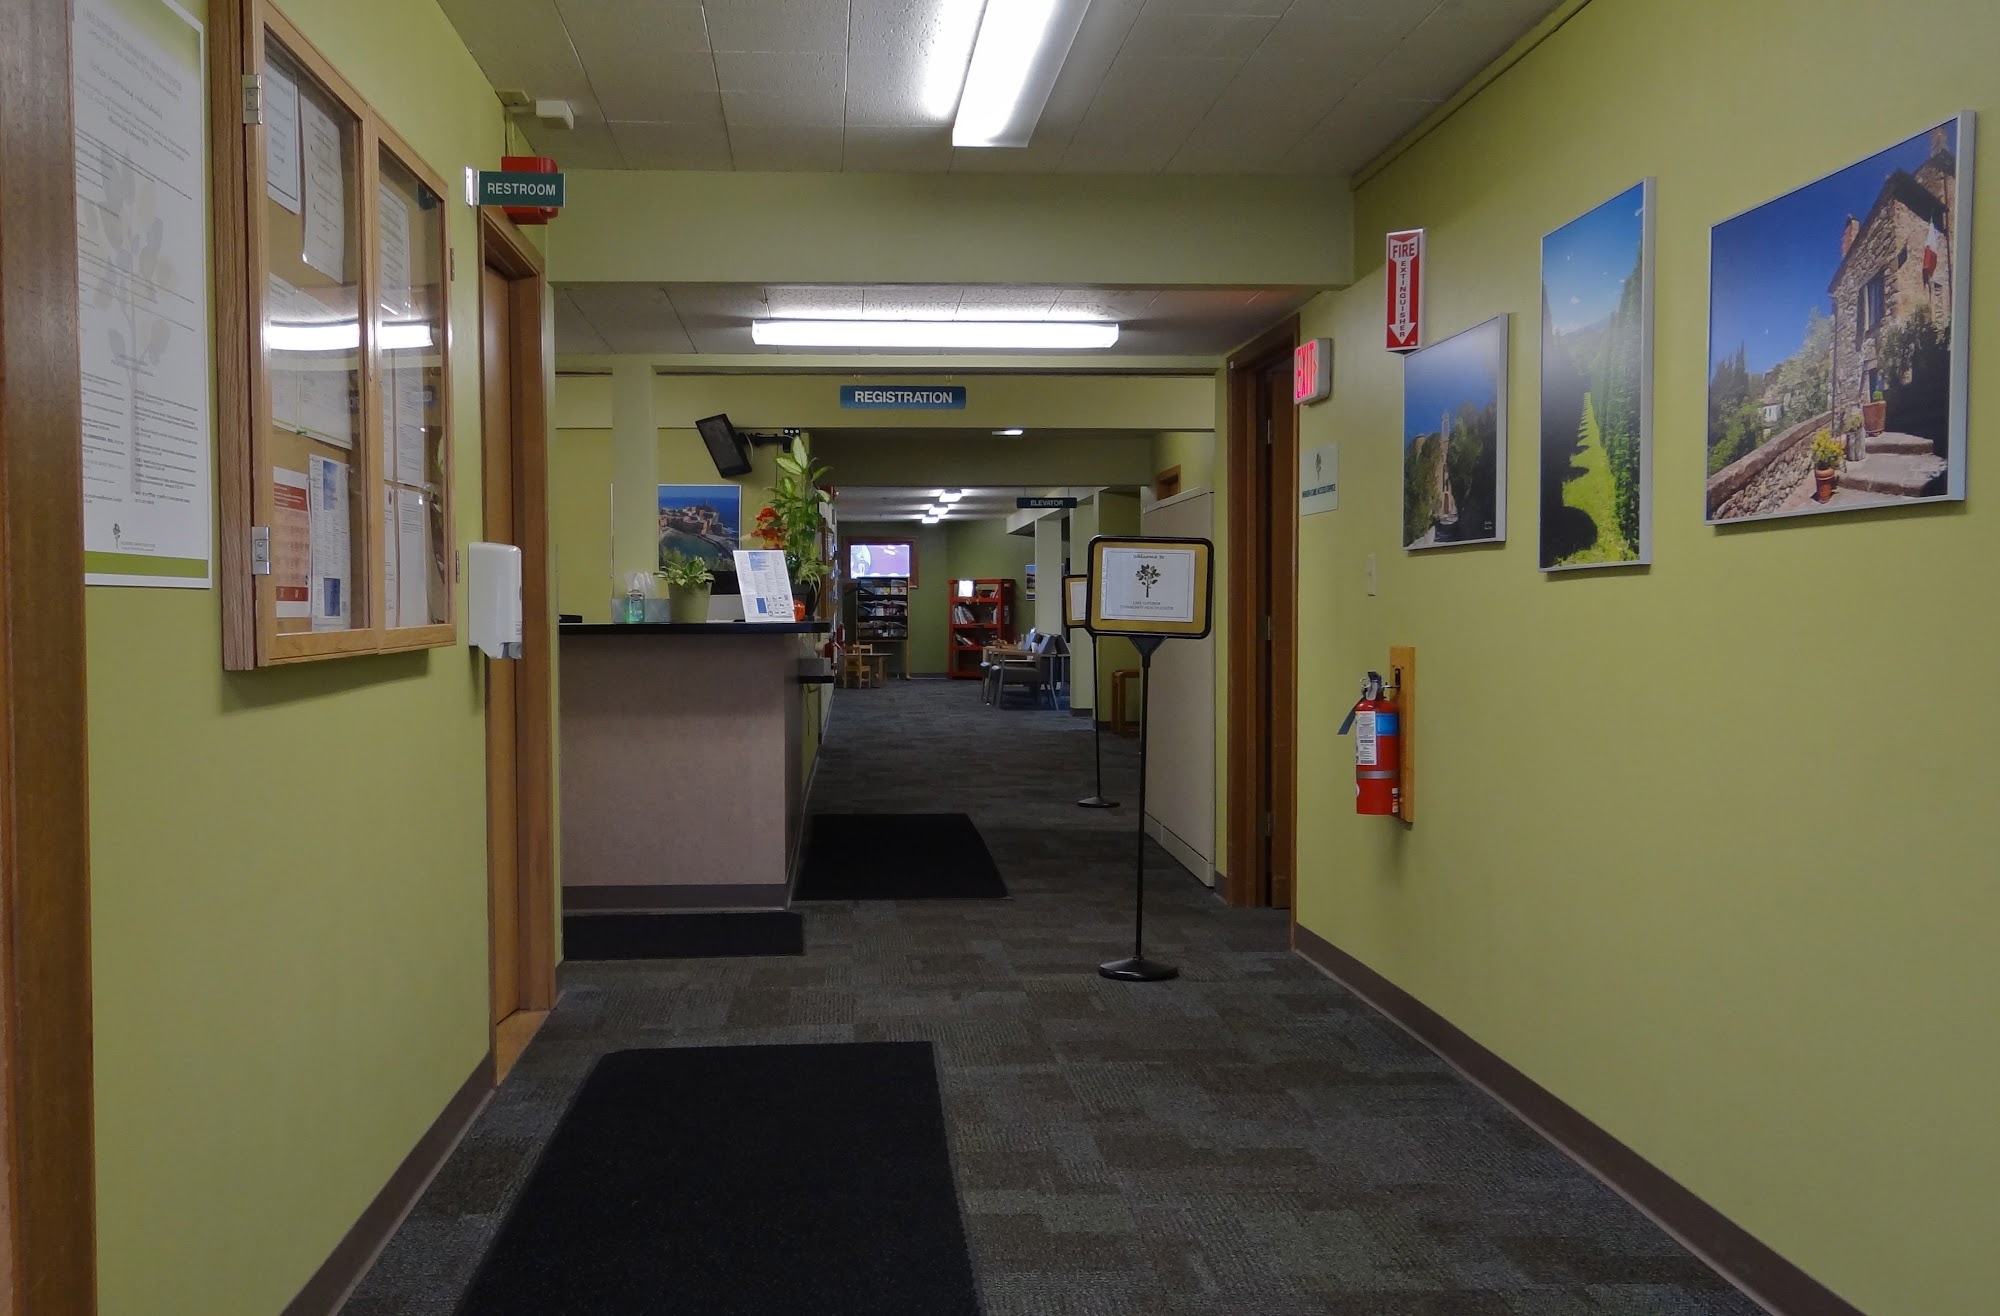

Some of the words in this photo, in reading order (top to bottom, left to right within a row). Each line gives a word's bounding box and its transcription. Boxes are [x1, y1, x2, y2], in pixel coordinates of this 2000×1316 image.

[487, 182, 556, 196] RESTROOM
[1392, 242, 1415, 259] FIRE
[1399, 260, 1407, 338] EXTINGUISHER
[1296, 342, 1315, 399] EXIT
[854, 390, 953, 404] REGISTRATION
[1030, 499, 1064, 507] ELEVATOR
